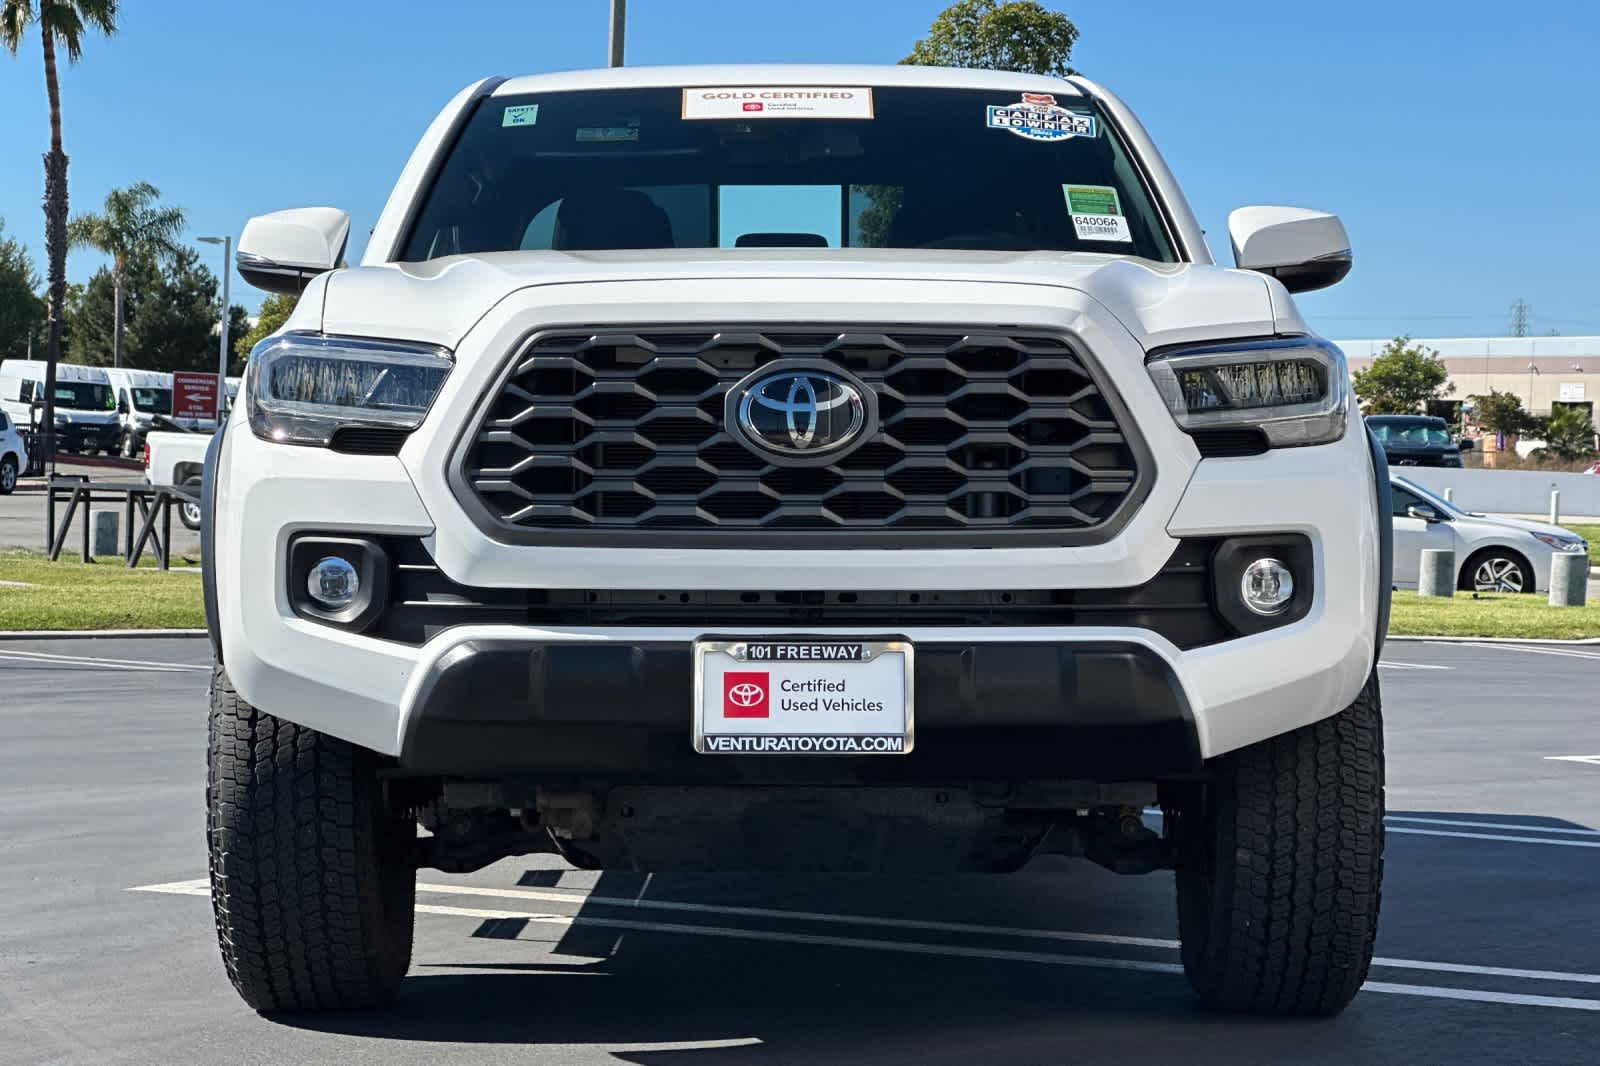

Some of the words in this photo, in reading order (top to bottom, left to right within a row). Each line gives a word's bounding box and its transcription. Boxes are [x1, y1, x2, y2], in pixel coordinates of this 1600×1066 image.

[702, 92, 755, 100] GOLD
[759, 92, 854, 100] CERTIFIED
[994, 109, 1089, 126] CARFAX
[1011, 119, 1089, 133] OWNER
[1074, 216, 1118, 226] 64006A
[750, 646, 771, 659] 101
[776, 646, 858, 659] FREEWAY
[780, 679, 846, 692] Certified
[781, 698, 818, 711] Used
[822, 698, 883, 711] Vehicles
[706, 737, 902, 751] VENTURATOYOTA.COM
